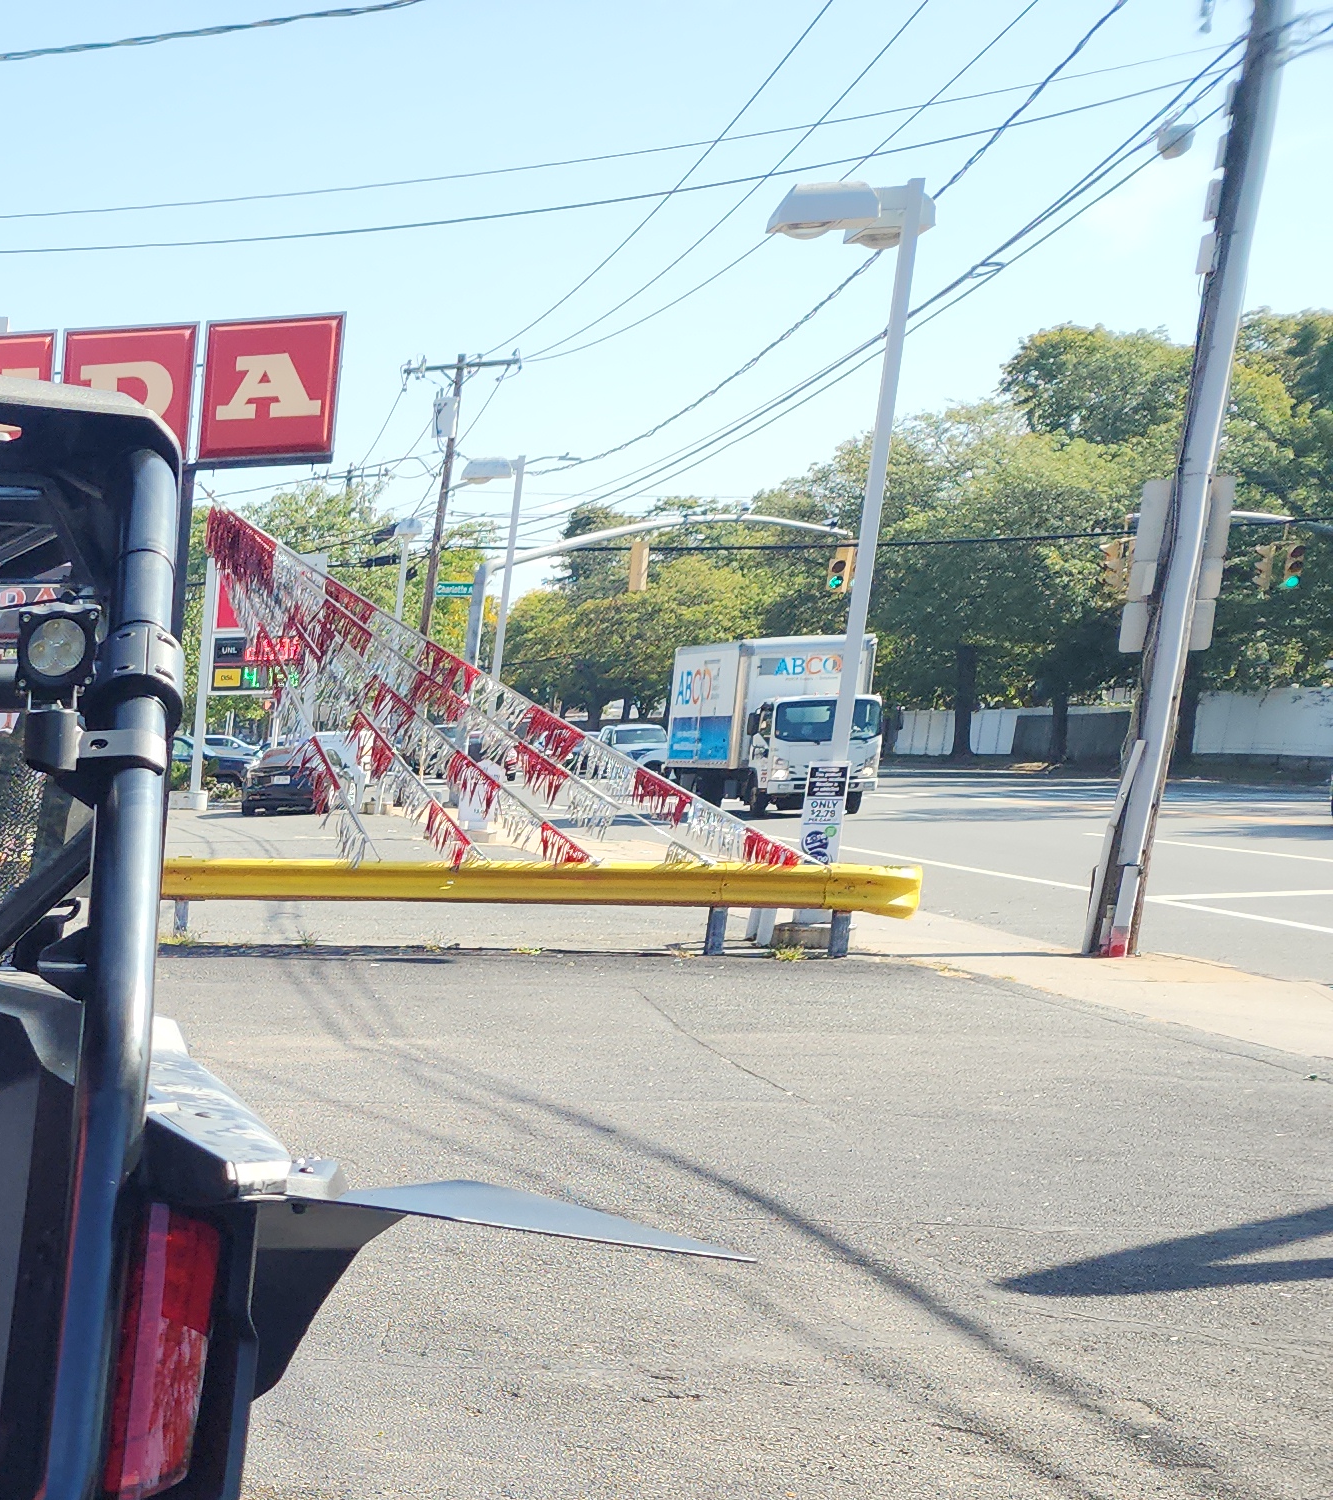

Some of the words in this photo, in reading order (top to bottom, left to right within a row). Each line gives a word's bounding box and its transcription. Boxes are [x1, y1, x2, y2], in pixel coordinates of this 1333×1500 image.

[2, 352, 321, 421] DA
[773, 655, 842, 676] ABCO
[675, 668, 712, 705] ABCO
